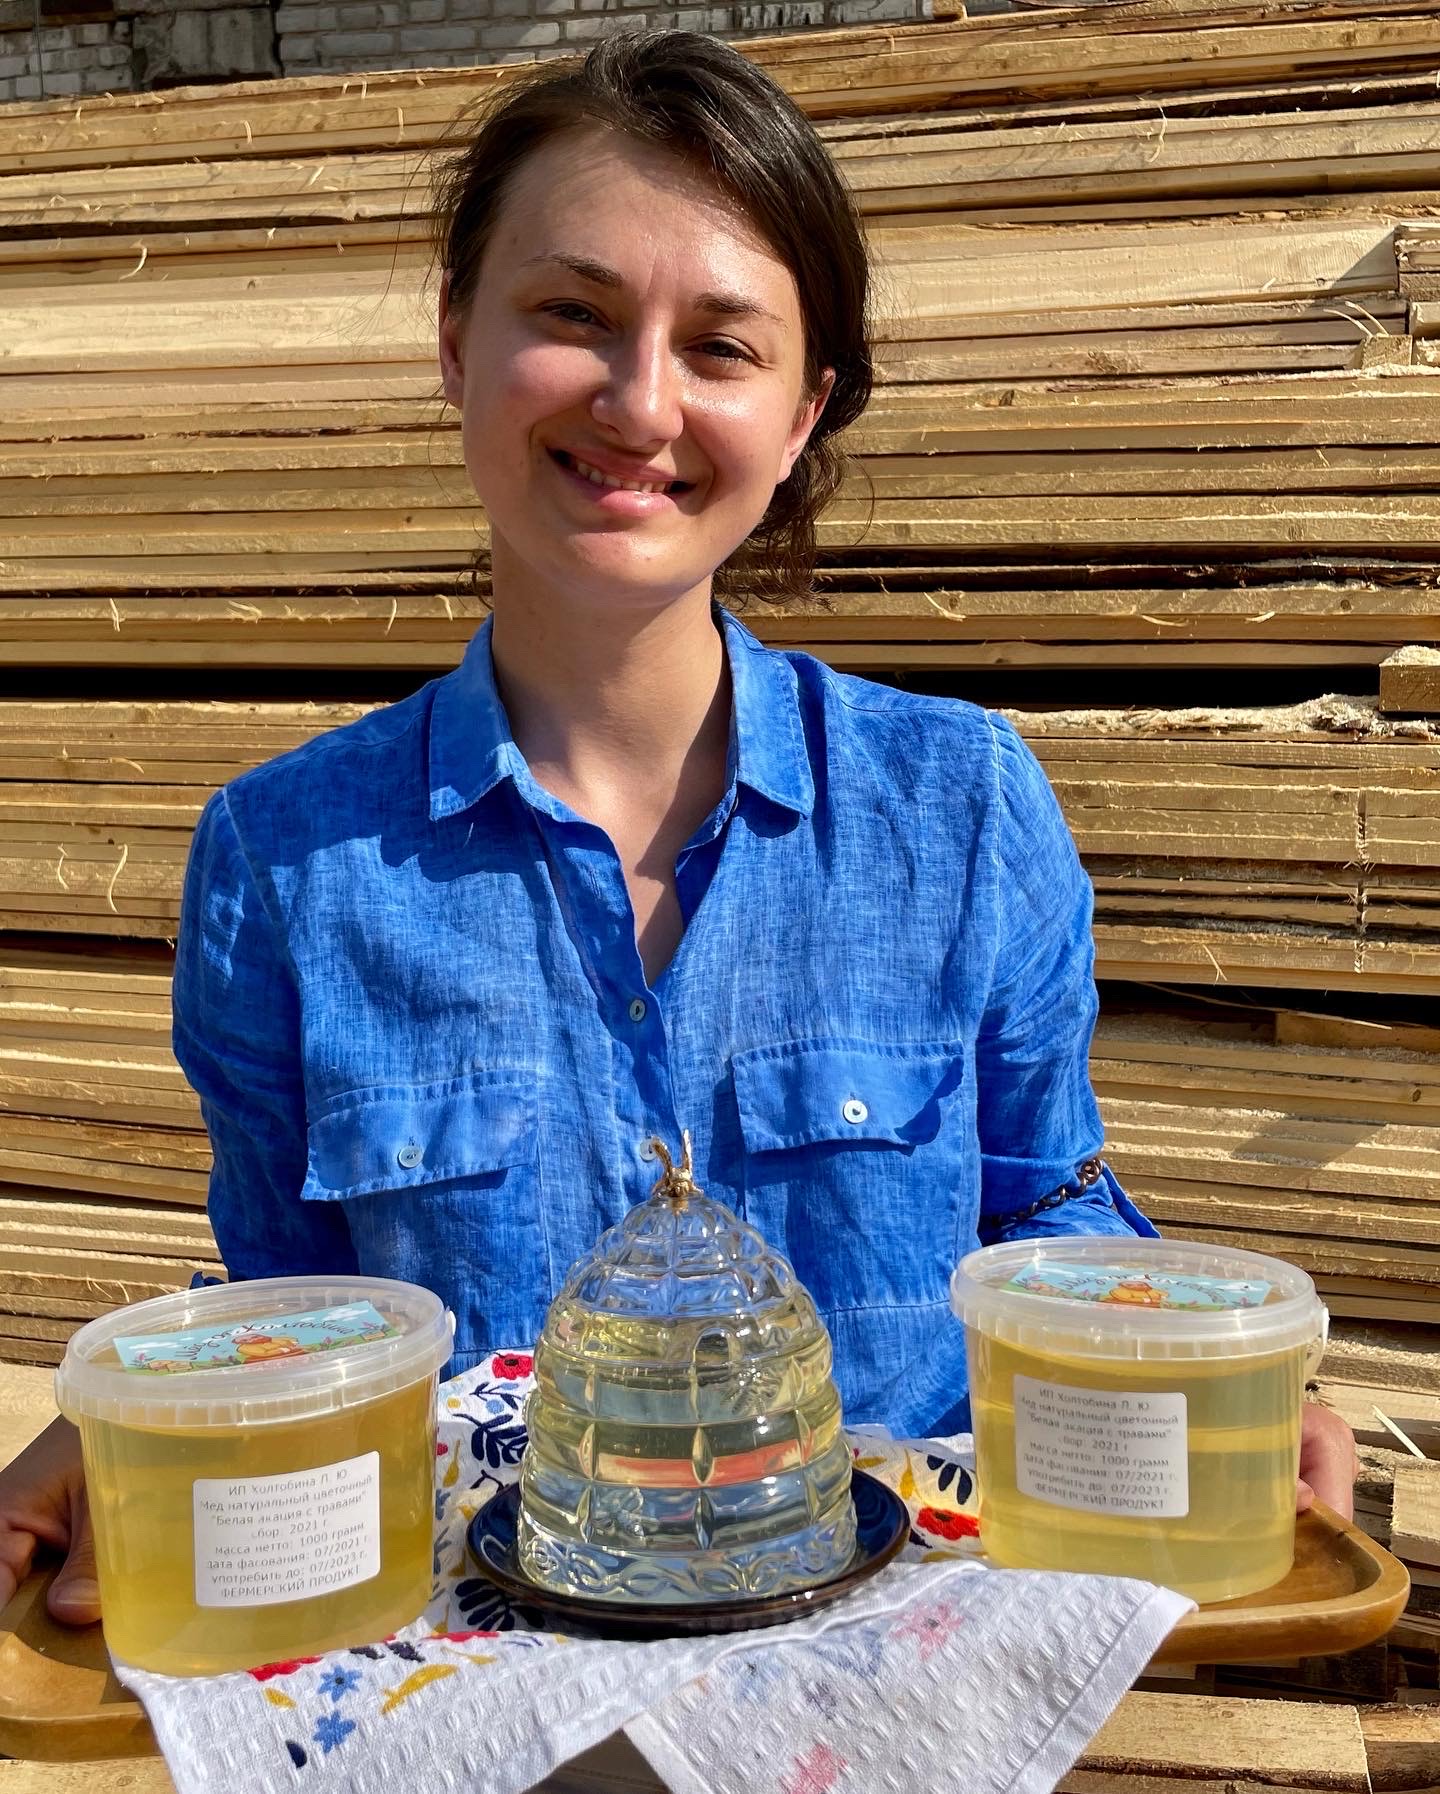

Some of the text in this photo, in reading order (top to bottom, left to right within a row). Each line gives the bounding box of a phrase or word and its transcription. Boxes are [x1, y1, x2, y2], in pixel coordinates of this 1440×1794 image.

[1040, 1388, 1054, 1399] ИП
[1114, 1415, 1179, 1426] цветочный
[1092, 1439, 1119, 1451] 2021
[1101, 1455, 1129, 1465] 1000
[1116, 1469, 1168, 1481] 07/2021
[228, 1490, 310, 1511] натуральный
[313, 1475, 372, 1500] цветочный
[229, 1487, 246, 1496] ИП
[258, 1509, 302, 1524] акация
[289, 1520, 318, 1535] 2021
[215, 1545, 250, 1554] масса
[300, 1532, 328, 1547] 1000
[332, 1522, 364, 1543] грамм
[315, 1538, 360, 1558] 07/2021
[212, 1571, 281, 1585] употребить
[310, 1553, 356, 1573] 07/2023
[221, 1566, 360, 1598] ФЕРМЕРСКИЙ ПРОДУКТ
